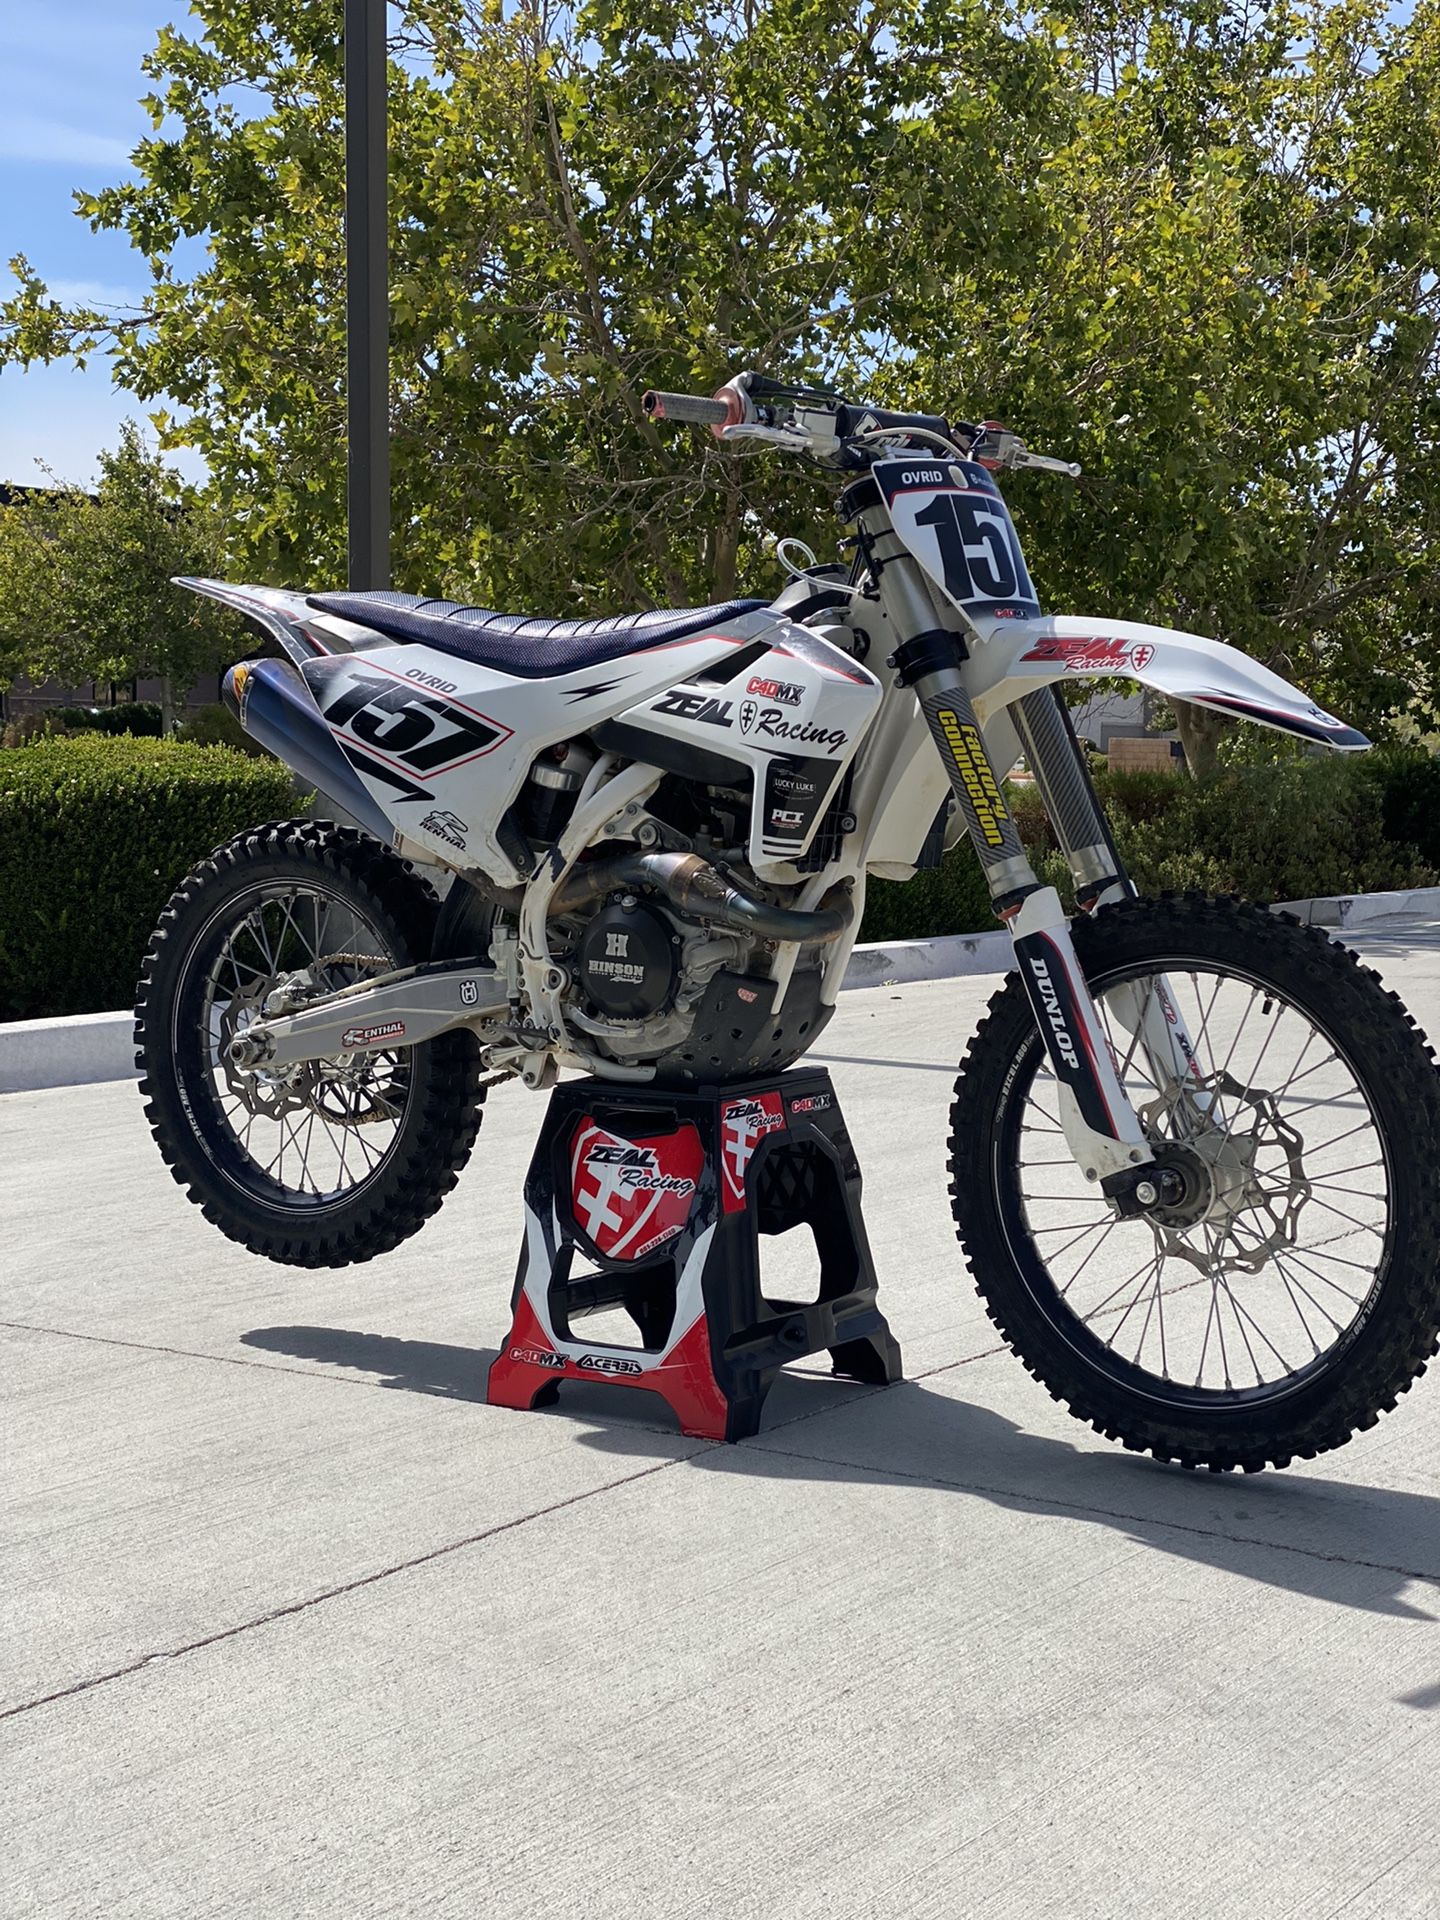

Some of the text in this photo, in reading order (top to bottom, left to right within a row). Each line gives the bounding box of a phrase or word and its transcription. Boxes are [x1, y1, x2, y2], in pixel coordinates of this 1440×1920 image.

[902, 471, 943, 485] OVRID
[1020, 637, 1132, 662] ZEAL
[1063, 655, 1128, 673] Racing
[405, 668, 458, 694] OVRID
[746, 676, 806, 706] C4DMX
[323, 673, 500, 771] 157
[650, 690, 849, 754] ZEAL Racing
[937, 709, 1005, 848] Connection
[961, 724, 1009, 821] Factory
[775, 778, 815, 791] LUCKY LUKE
[419, 821, 467, 852] RENTHAL
[588, 960, 645, 977] HINSON
[1029, 957, 1080, 1069] DUNLOP
[723, 1100, 763, 1121] ZEAL
[791, 1094, 831, 1114] C4DMX
[748, 1113, 783, 1129] Racing
[584, 1146, 656, 1168] ZEAL
[619, 1168, 696, 1197] Racing
[509, 1349, 569, 1369] C4DMX
[580, 1356, 643, 1375] ACERBIS
